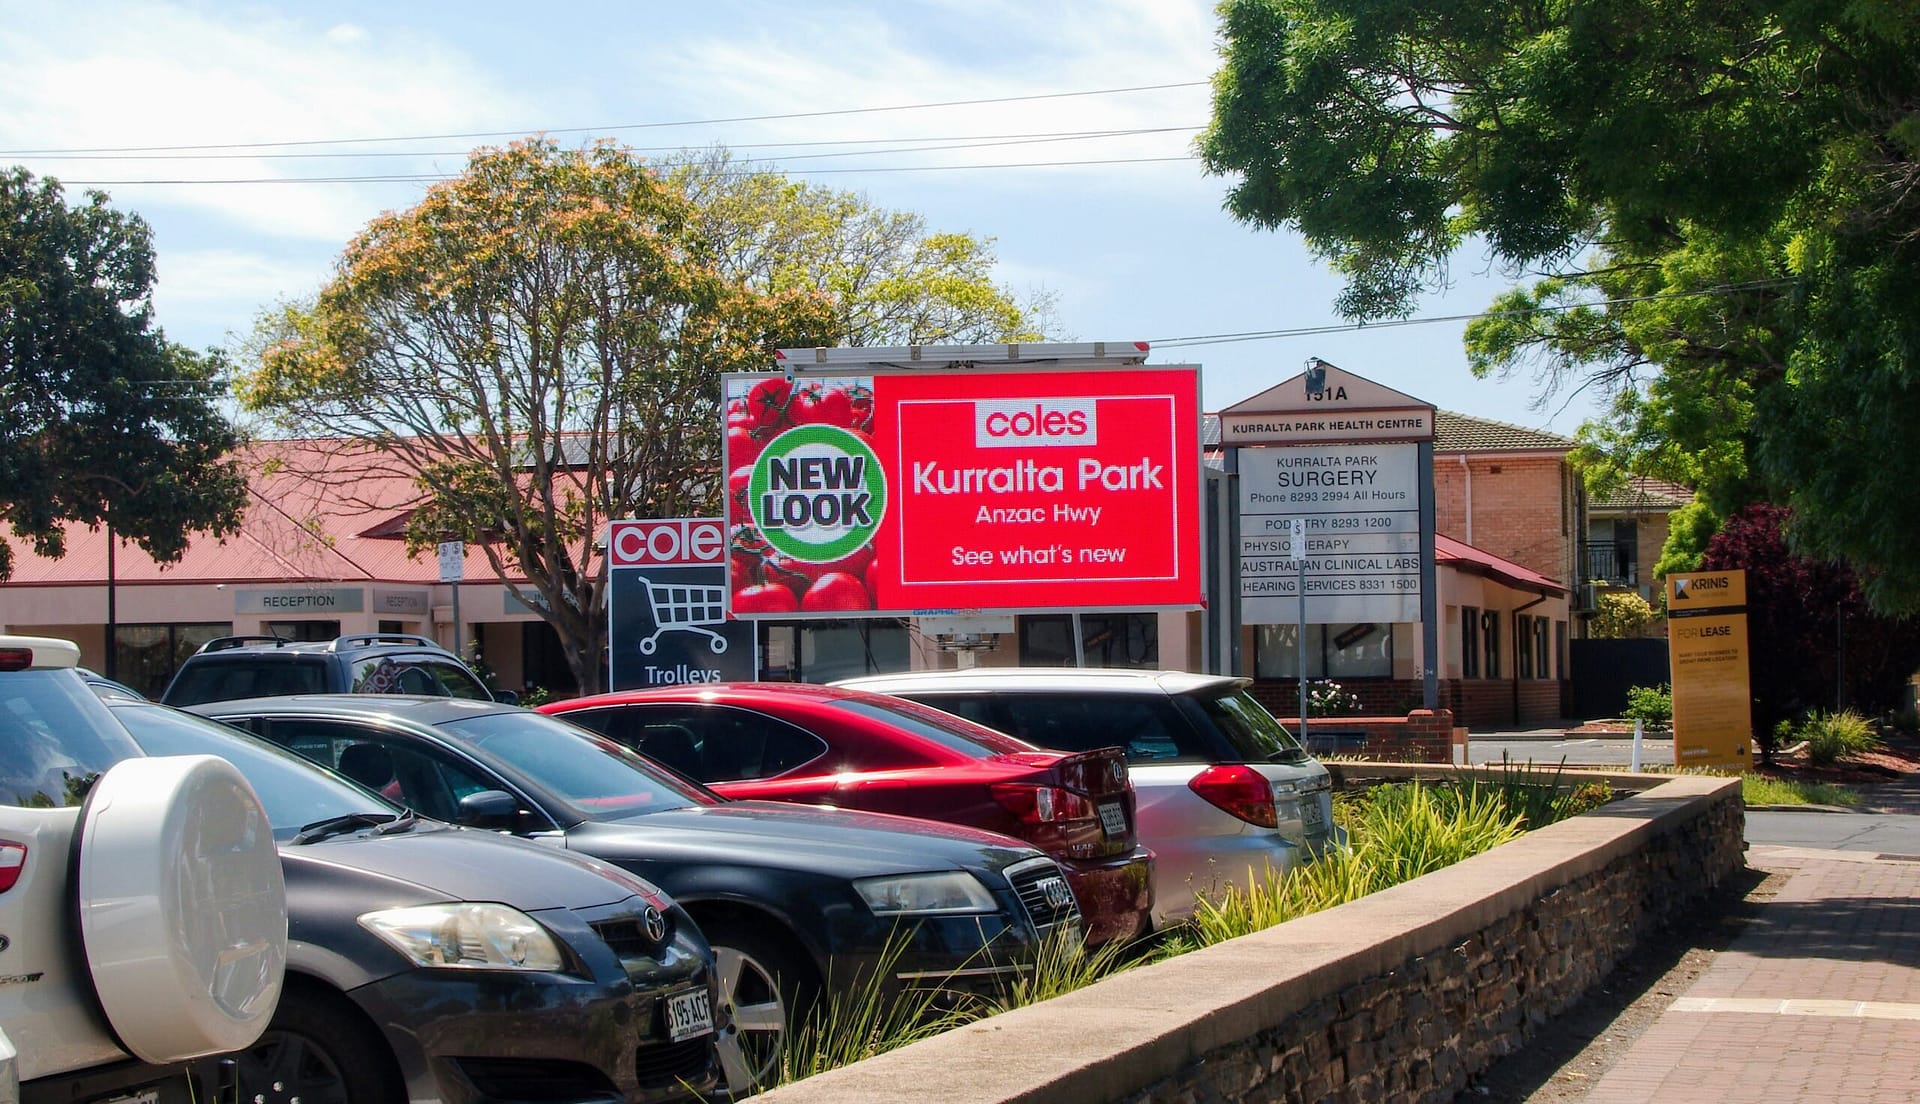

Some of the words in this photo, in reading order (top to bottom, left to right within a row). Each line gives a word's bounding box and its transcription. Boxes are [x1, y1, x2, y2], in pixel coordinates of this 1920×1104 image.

[985, 404, 1088, 437] coles
[1233, 423, 1292, 434] KURRALTA
[1296, 422, 1325, 432] PARK
[1330, 420, 1373, 430] HEALTH
[1377, 418, 1423, 429] CENTRE
[1277, 456, 1342, 468] KURRALTA
[1345, 455, 1378, 466] PARK
[770, 457, 864, 490] NEW
[913, 459, 1064, 494] Kurralta
[1078, 456, 1164, 490] Park
[1278, 470, 1377, 488] SURGERY
[1250, 493, 1286, 503] Phone
[1290, 491, 1318, 502] 8293
[1322, 491, 1350, 501] 2994
[1353, 490, 1368, 500] All
[1372, 489, 1406, 500] Hours
[763, 493, 871, 527] LOOK
[975, 505, 1046, 524] Anzac
[1053, 504, 1101, 526] Hwy
[1265, 519, 1327, 530] PODTRY
[1331, 518, 1360, 529] 8293
[1364, 517, 1392, 528] 1200
[614, 521, 726, 562] cole
[1244, 539, 1350, 552] PHYSIOERAPY
[951, 546, 993, 566] See
[1000, 544, 1073, 565] what's
[1079, 547, 1126, 563] new
[1241, 560, 1321, 572] AUSTRALAN
[1324, 559, 1382, 570] CLINICAL
[1386, 558, 1419, 569] LABS
[1243, 581, 1296, 593] HEARING
[1359, 579, 1385, 590] 8331
[1391, 579, 1417, 589] 1500
[1691, 577, 1729, 590] KRINIS
[263, 595, 335, 607] RECEPTION
[1700, 625, 1732, 637] LEASE
[645, 664, 721, 684] Trolleys
